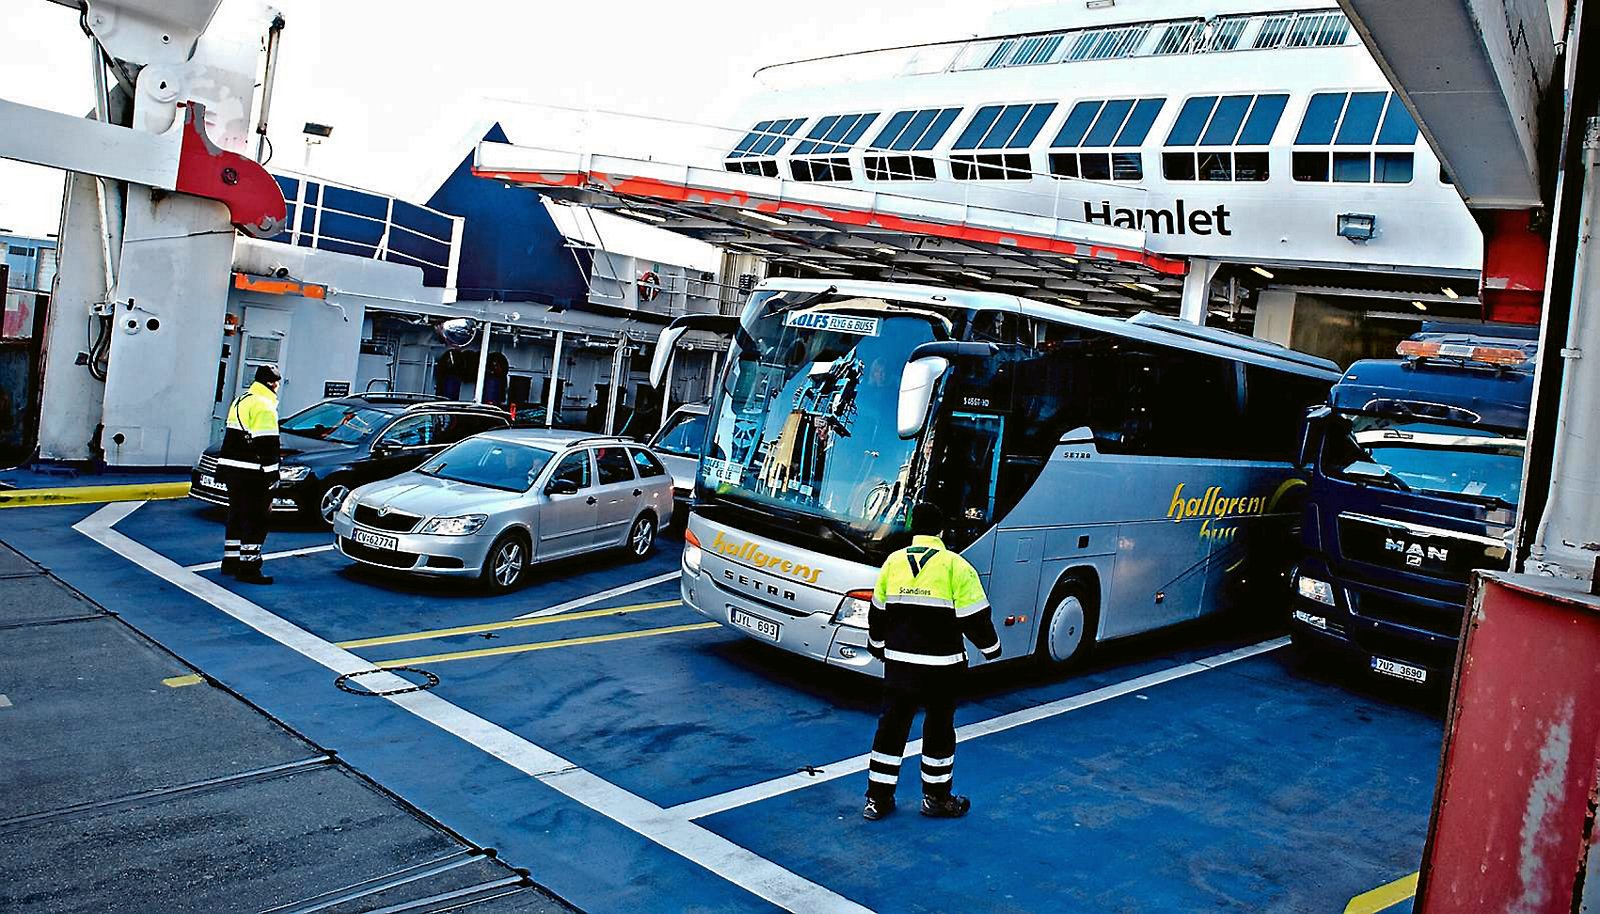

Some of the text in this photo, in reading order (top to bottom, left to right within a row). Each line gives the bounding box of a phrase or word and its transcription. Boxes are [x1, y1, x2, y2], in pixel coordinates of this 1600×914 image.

[1084, 199, 1231, 236] Hamlet
[829, 318, 847, 329] FLYG
[847, 320, 854, 329] &
[854, 321, 875, 331] BUSS
[1064, 451, 1091, 459] SETRA
[357, 531, 367, 542] CV
[369, 534, 394, 549] 62774
[1384, 538, 1449, 561] MAN
[712, 529, 824, 584] hallgrens
[724, 568, 796, 601] SETRA
[735, 613, 776, 636] JYL 693
[1378, 659, 1394, 671] 7U2
[1400, 666, 1423, 679] 3690
